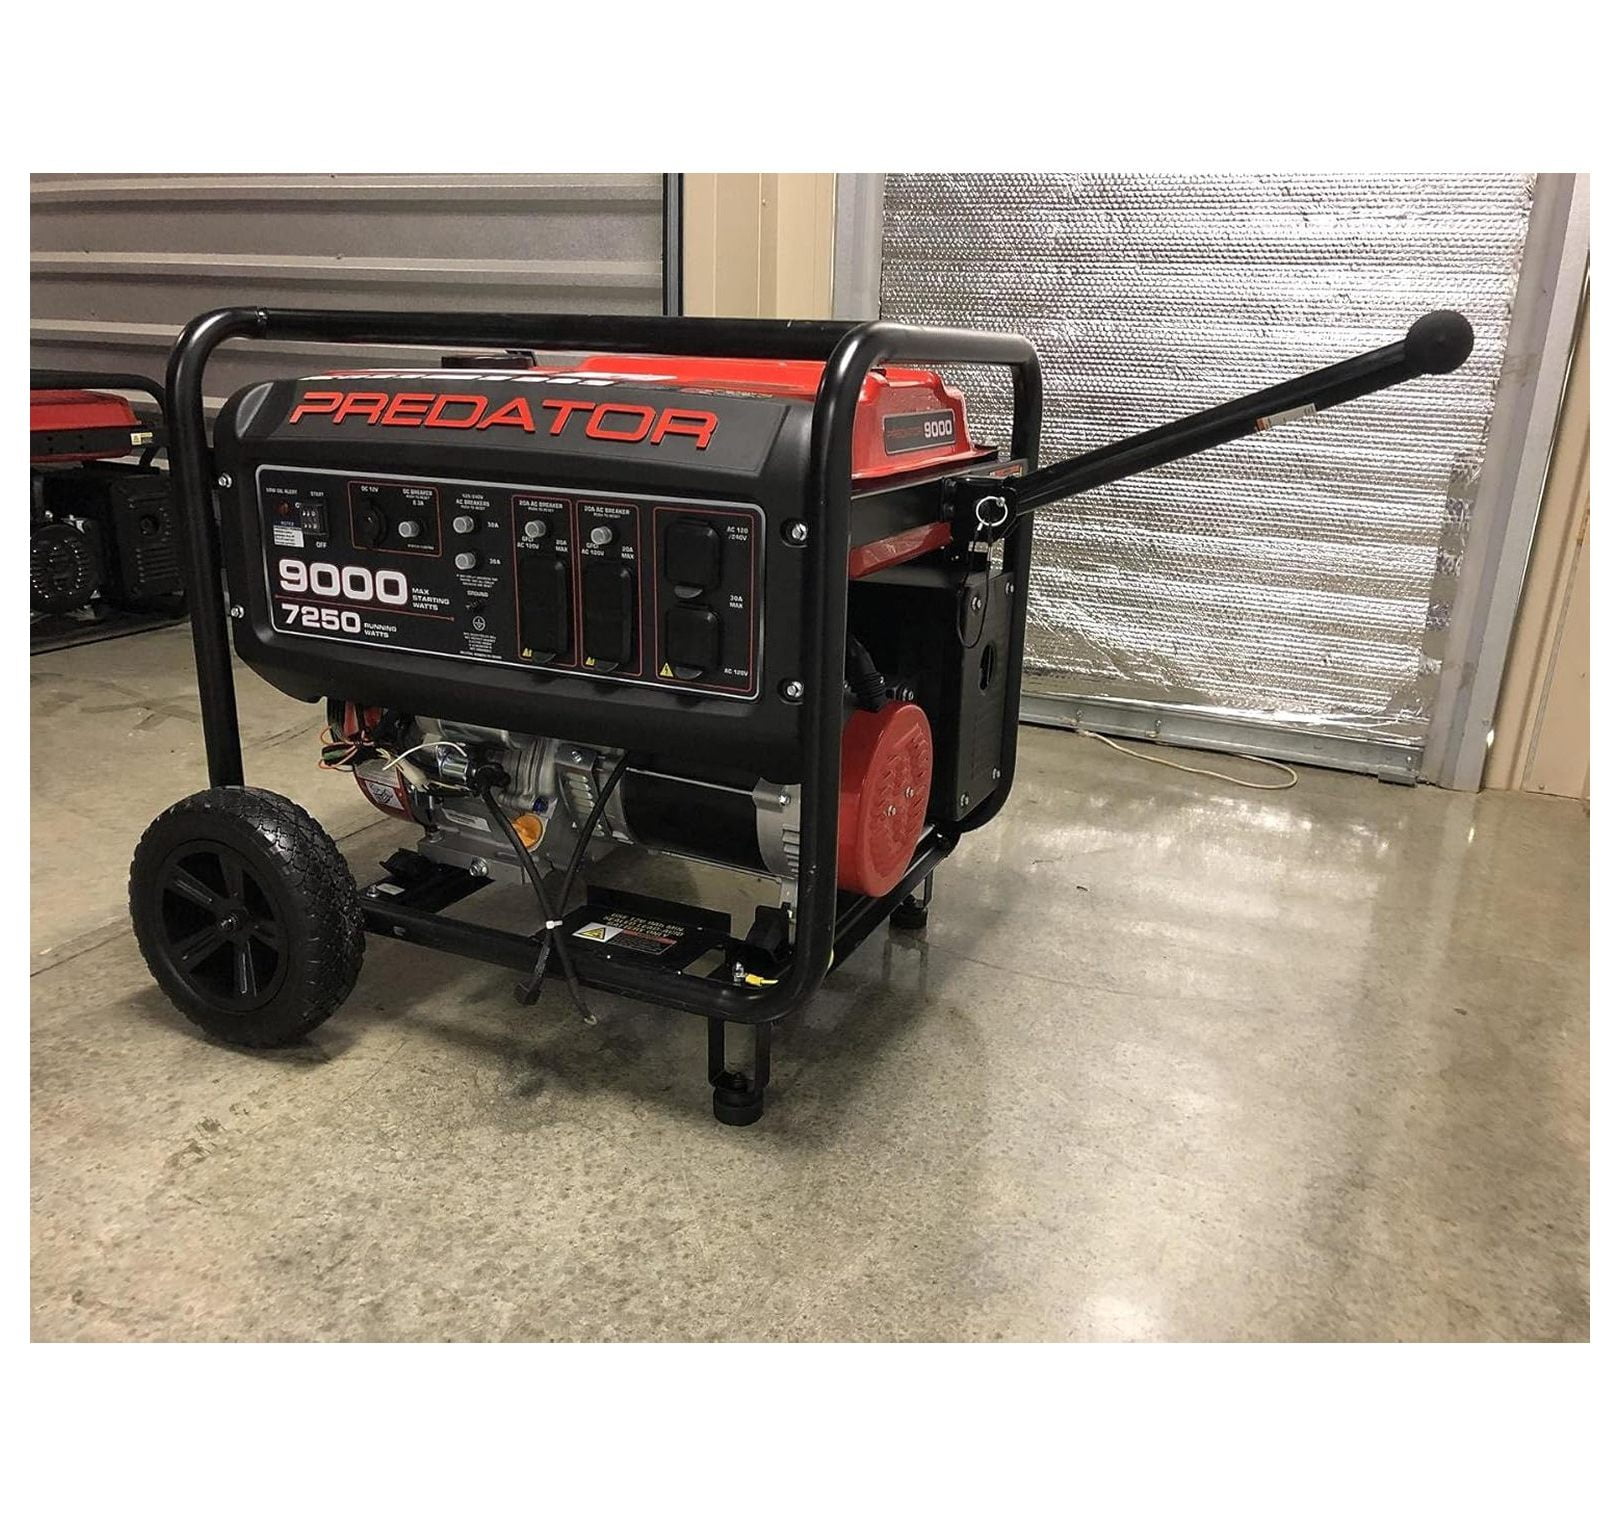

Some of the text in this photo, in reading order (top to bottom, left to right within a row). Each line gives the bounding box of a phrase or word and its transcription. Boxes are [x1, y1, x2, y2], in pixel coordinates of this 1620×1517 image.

[289, 391, 720, 450] PREDATOR
[923, 420, 953, 439] 9000
[605, 507, 630, 515] BREAKER
[726, 525, 735, 533] AC
[278, 558, 408, 605] 9000
[412, 587, 430, 596] MAX
[412, 594, 450, 605] STARTING
[730, 594, 743, 602] 30A
[412, 602, 439, 611] WATTS
[281, 603, 361, 633] 7250
[364, 622, 397, 633] RUNNING
[364, 629, 389, 638] WATTS
